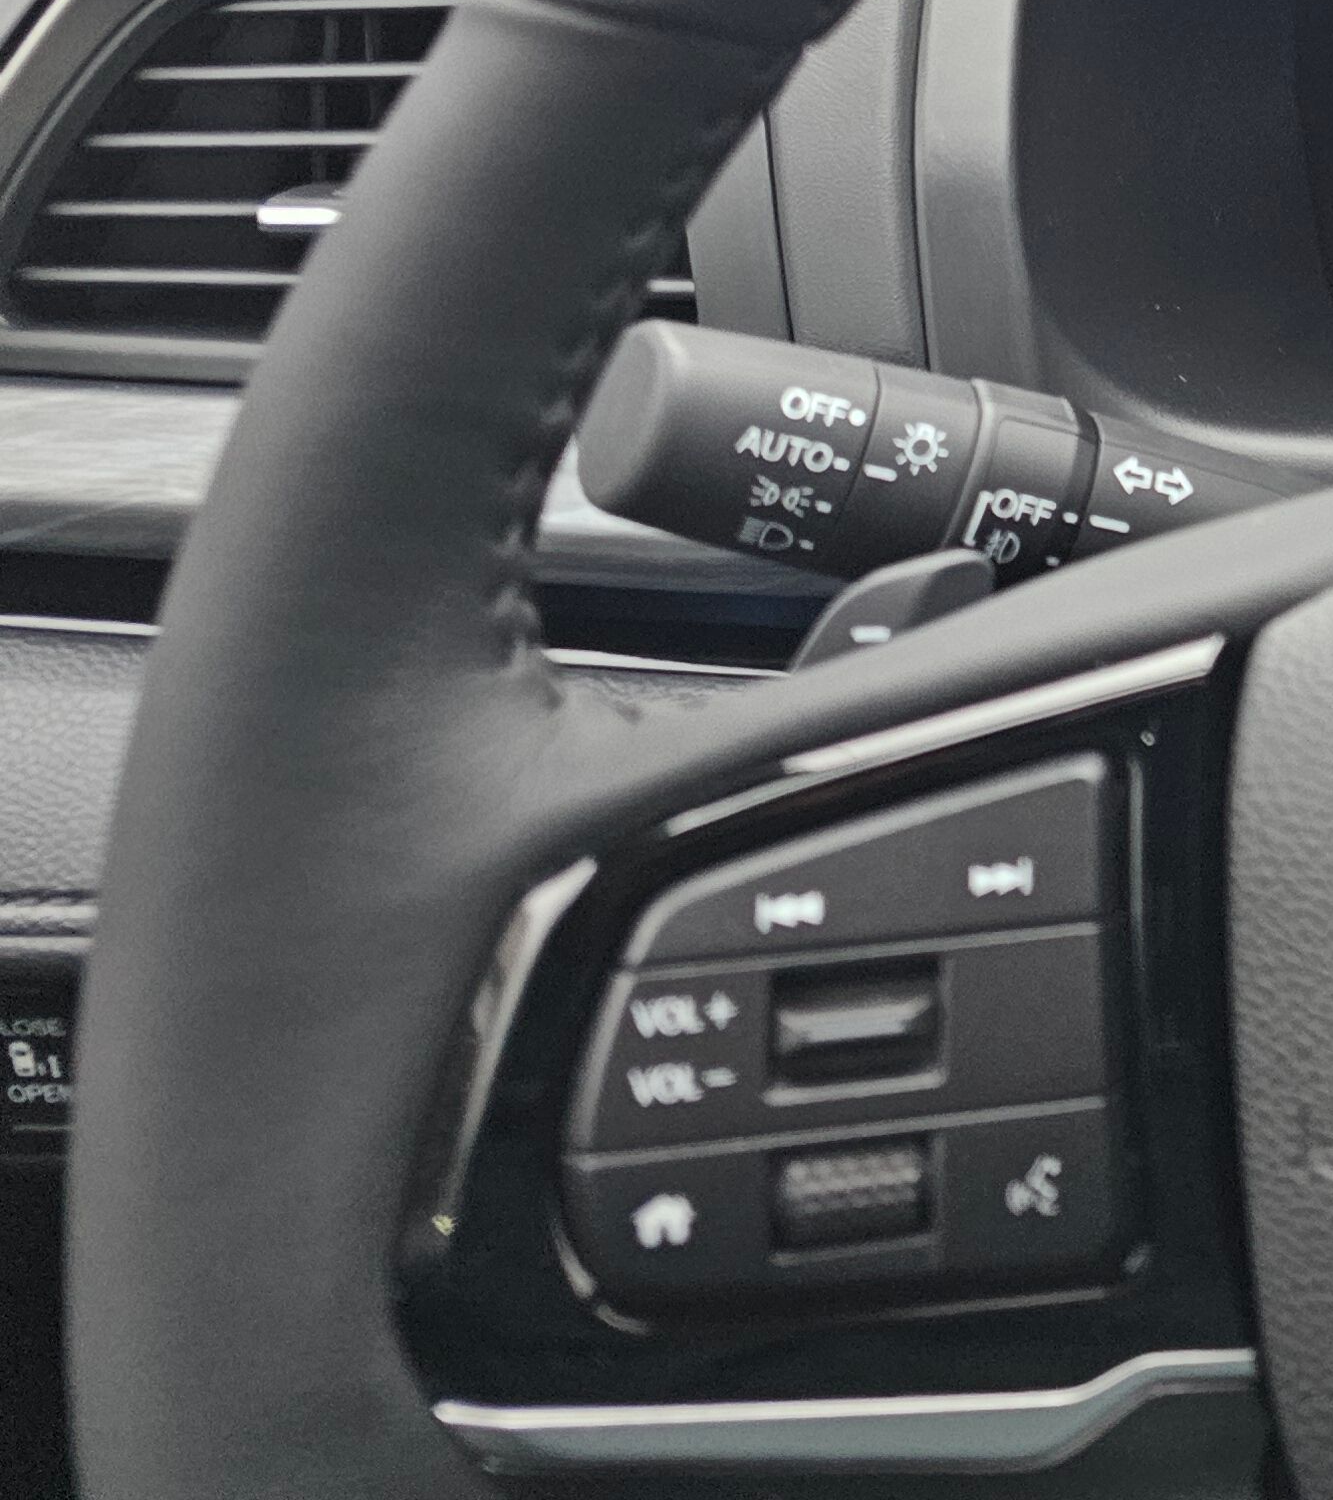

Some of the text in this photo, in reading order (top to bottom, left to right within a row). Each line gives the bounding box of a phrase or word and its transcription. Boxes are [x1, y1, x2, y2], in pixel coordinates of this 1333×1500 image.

[781, 387, 849, 426] OFF
[735, 427, 833, 471] AUTO
[990, 489, 1056, 524] OFF
